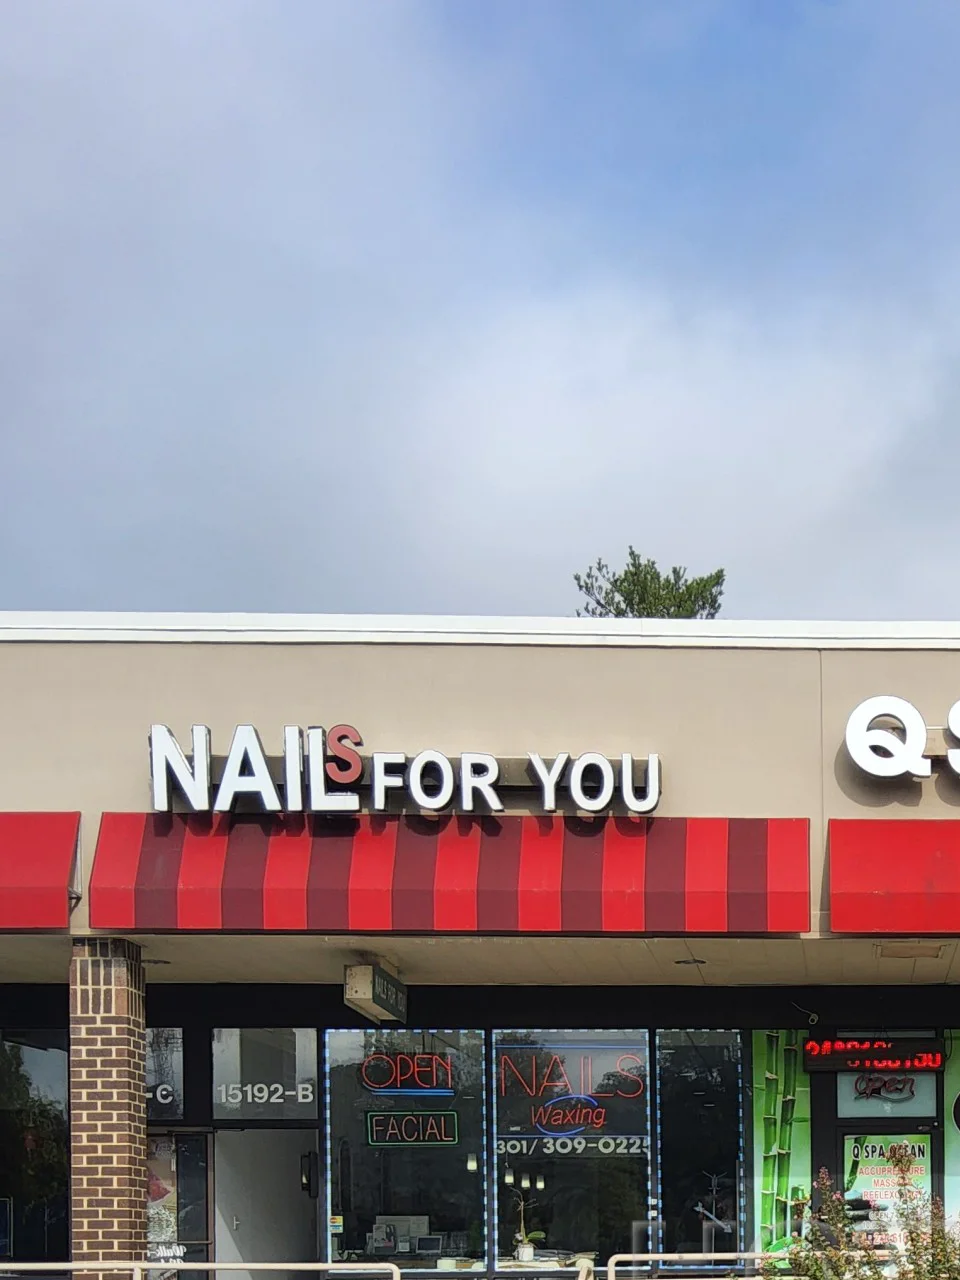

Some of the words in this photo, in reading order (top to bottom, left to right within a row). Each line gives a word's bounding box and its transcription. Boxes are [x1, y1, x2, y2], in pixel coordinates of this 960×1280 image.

[844, 694, 932, 779] Q
[149, 723, 364, 813] NAILS
[373, 751, 504, 813] FOR
[528, 751, 661, 813] YOU
[361, 1053, 454, 1090] OPEN
[500, 1053, 645, 1098] NAILS
[217, 1083, 315, 1103] 15192-B
[373, 1114, 454, 1142] FACIAL
[530, 1102, 607, 1129] Waxing
[852, 1144, 861, 1160] Q
[864, 1144, 885, 1159] SPA
[858, 1166, 925, 1176] ACCUPREURE
[873, 1178, 914, 1188] MASS
